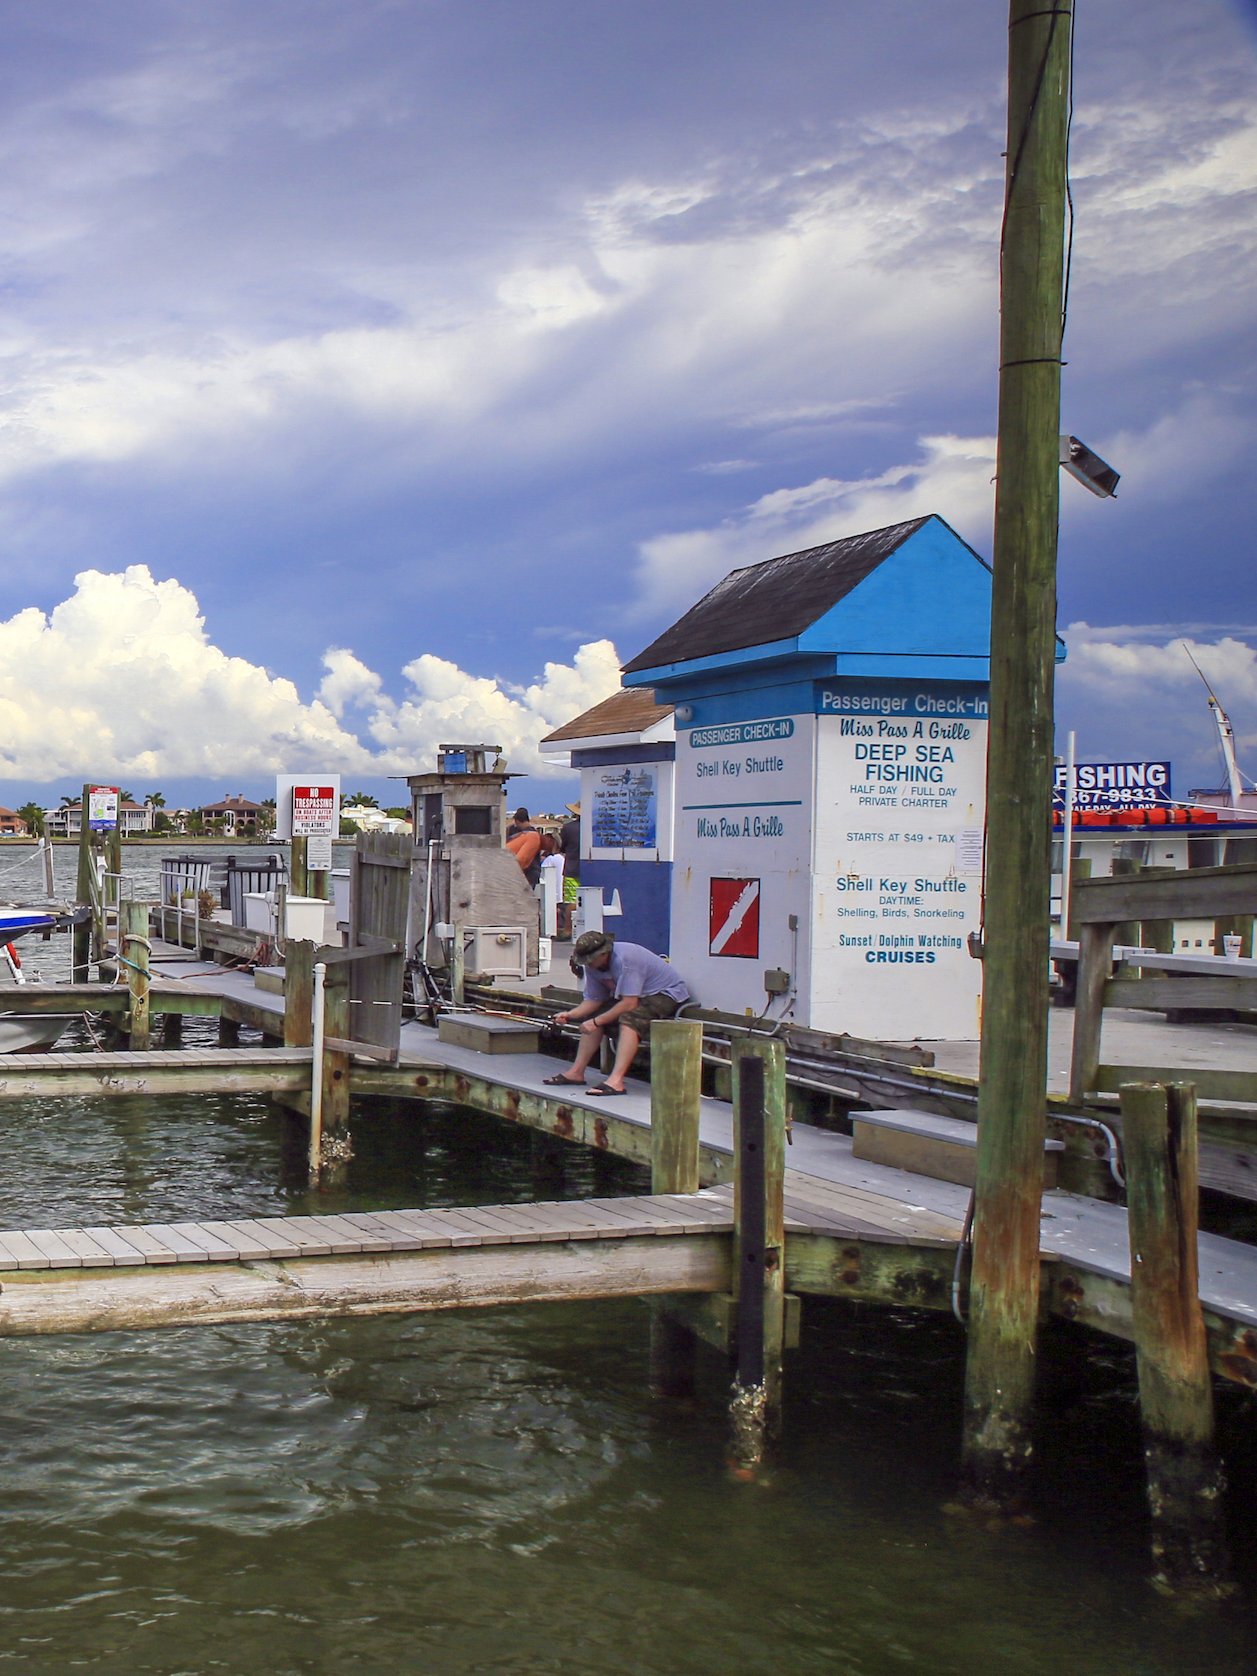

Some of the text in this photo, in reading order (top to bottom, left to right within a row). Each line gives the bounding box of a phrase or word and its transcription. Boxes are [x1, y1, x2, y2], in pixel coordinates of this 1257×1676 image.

[822, 691, 989, 714] Passenger Check-In
[692, 722, 790, 745] PASSENGER CHECK-IN
[840, 718, 971, 740] Miss Pass A Grille
[855, 743, 954, 763] DEEP SEA
[696, 756, 784, 777] Shell Key Shuttle
[865, 764, 944, 782] FISHING
[1055, 764, 1167, 788] FISHING
[309, 787, 319, 798] NO
[850, 785, 875, 794] HALF
[879, 786, 898, 794] DAY
[911, 787, 934, 796] FULL
[939, 788, 957, 796] DAY
[295, 798, 333, 808] TRESPASSING
[859, 797, 948, 807] PRIVATE CHARTER
[697, 816, 784, 838] Miss Pass A Grille
[846, 833, 884, 842] STARTS
[888, 833, 900, 842] AT
[904, 833, 924, 843] $49
[937, 834, 955, 843] TAX
[836, 877, 967, 895] Shell Key Shuttle
[879, 896, 924, 905] DAYTIME:
[837, 908, 965, 919] Shelling, Birds, Snorkeling
[918, 935, 962, 949] Watching
[865, 951, 936, 963] CRUISES
